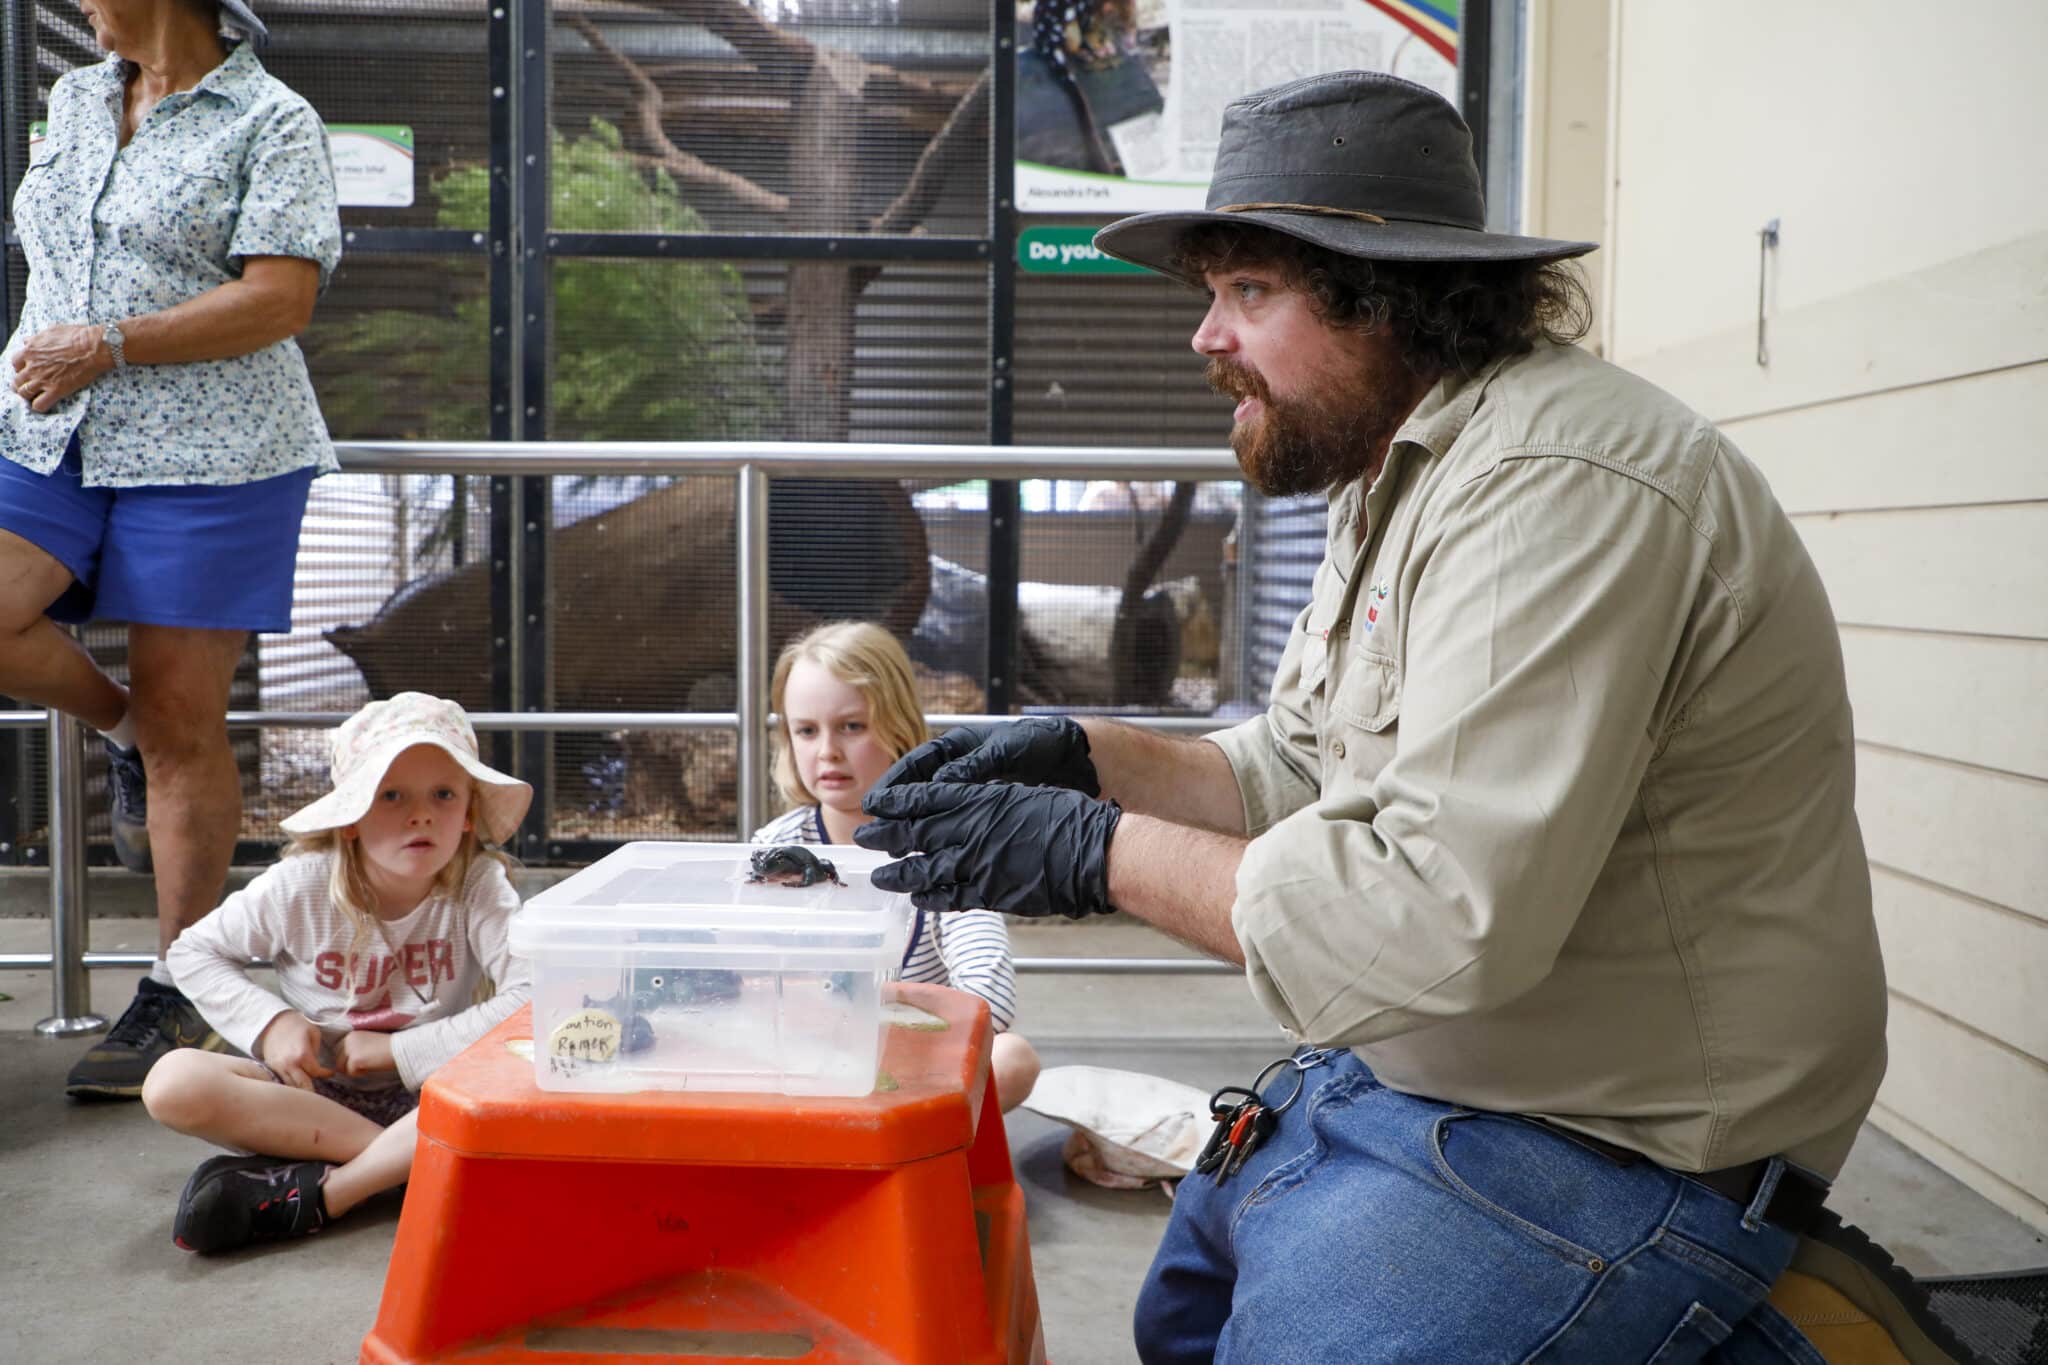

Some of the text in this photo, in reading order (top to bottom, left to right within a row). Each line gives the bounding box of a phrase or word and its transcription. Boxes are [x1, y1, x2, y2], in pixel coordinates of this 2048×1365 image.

[1087, 187, 1110, 198] Park
[1029, 241, 1100, 265] Do you
[314, 938, 455, 995] SUPER
